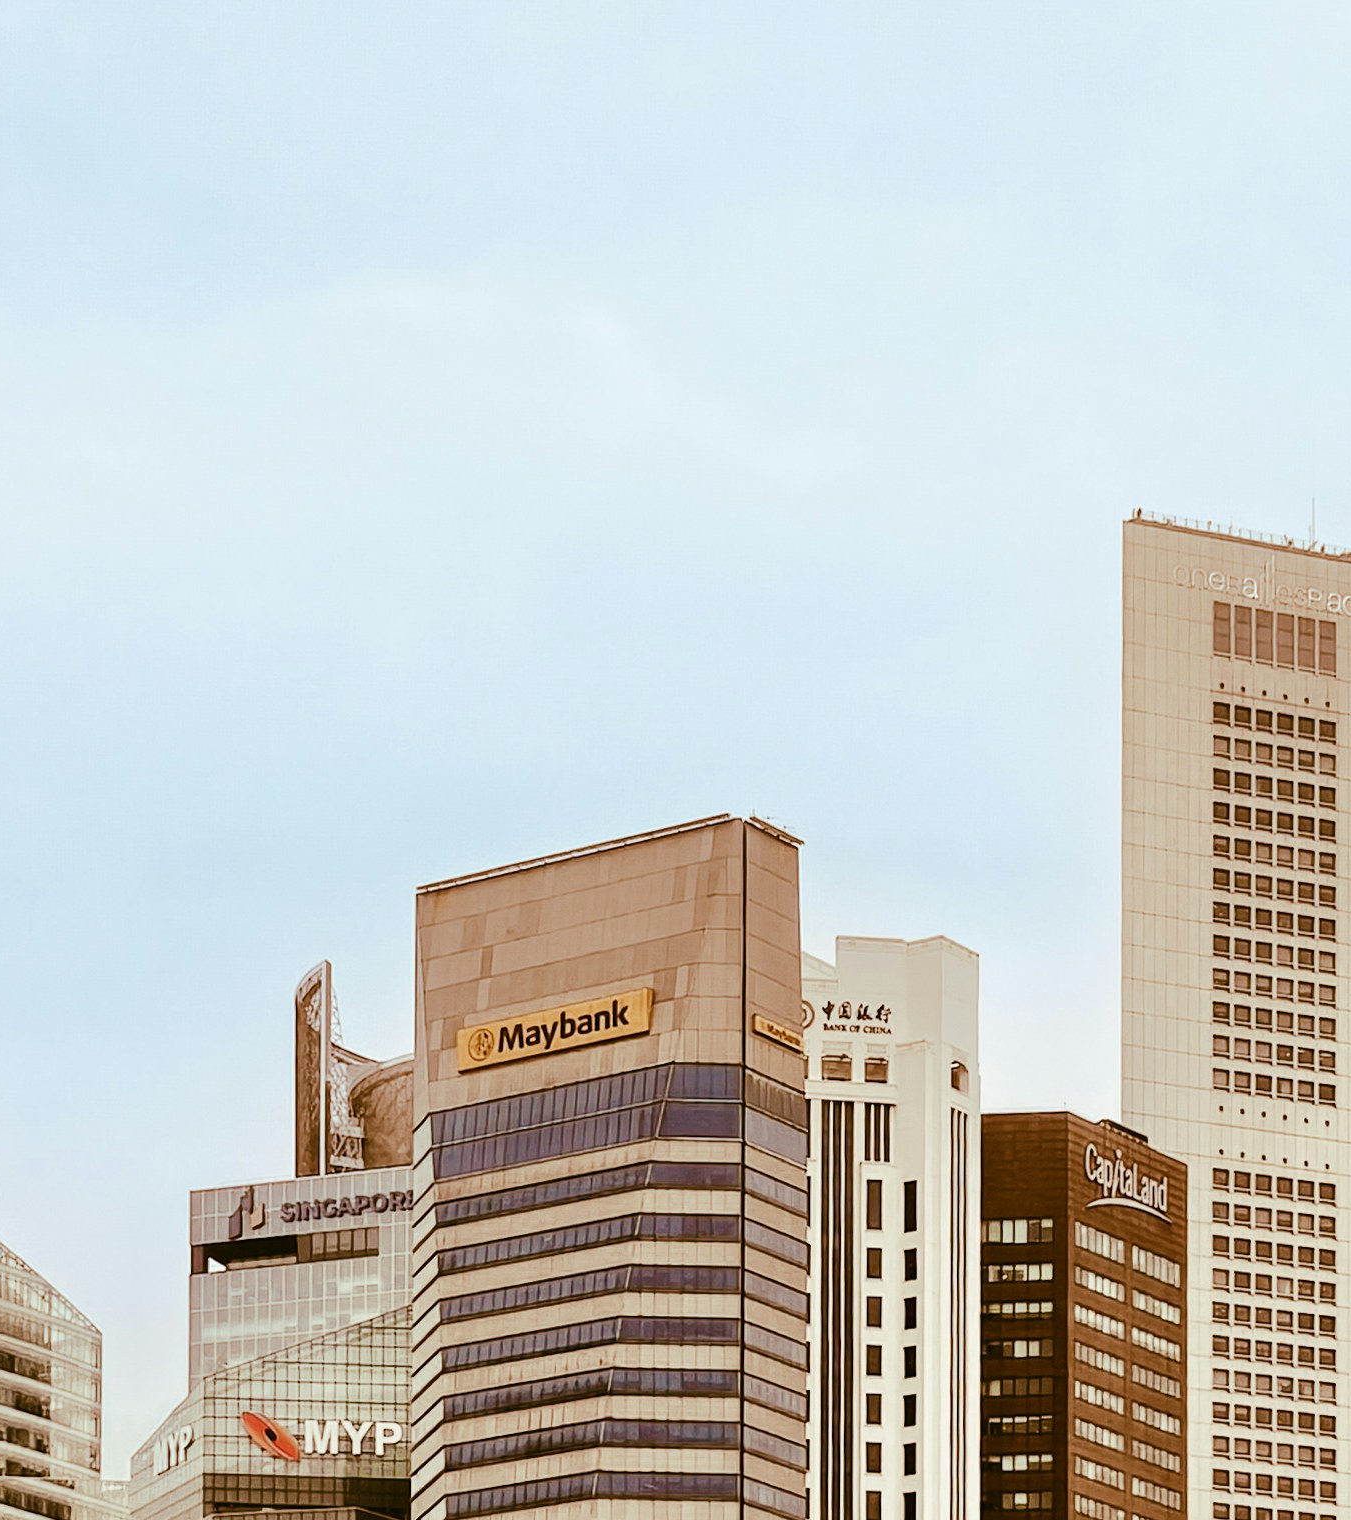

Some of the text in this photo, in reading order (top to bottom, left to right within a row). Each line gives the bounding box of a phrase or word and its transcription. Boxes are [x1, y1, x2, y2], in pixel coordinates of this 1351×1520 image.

[497, 999, 630, 1052] Maybank
[823, 1023, 892, 1034] BANK OF CHINA
[1085, 1143, 1168, 1213] CapitaLand
[153, 1424, 195, 1476] MYP
[304, 1419, 404, 1457] MYP
